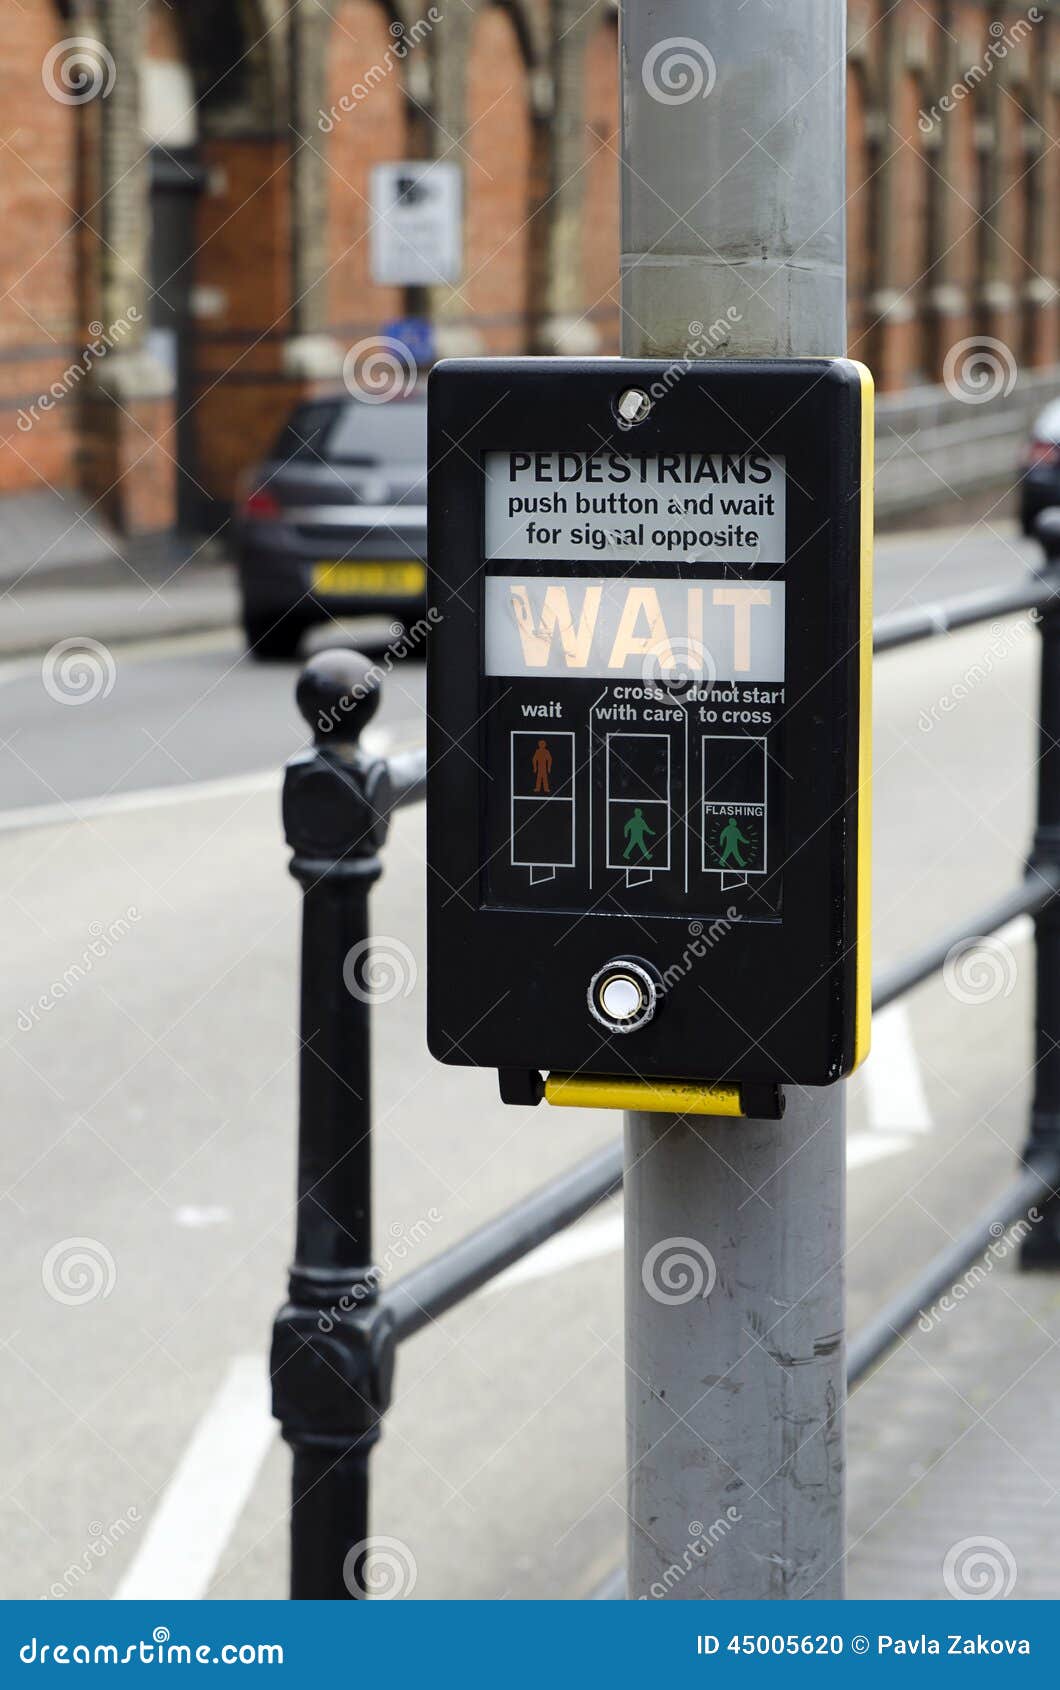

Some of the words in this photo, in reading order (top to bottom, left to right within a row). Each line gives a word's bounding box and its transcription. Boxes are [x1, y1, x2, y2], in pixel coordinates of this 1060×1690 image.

[508, 452, 772, 484] PEDESTRIANS
[508, 492, 567, 517] push
[576, 492, 658, 514] button
[667, 493, 713, 515] and
[720, 493, 775, 516] wait
[526, 522, 562, 544] for
[651, 524, 760, 550] opposite
[509, 584, 771, 671] WAIT
[613, 685, 664, 700] cross
[686, 685, 708, 702] do
[711, 686, 740, 702] not
[521, 701, 562, 718] wait
[595, 704, 639, 721] with
[643, 707, 684, 722] care
[699, 706, 719, 723] to
[722, 708, 772, 724] cross
[705, 805, 763, 818] FLASHING
